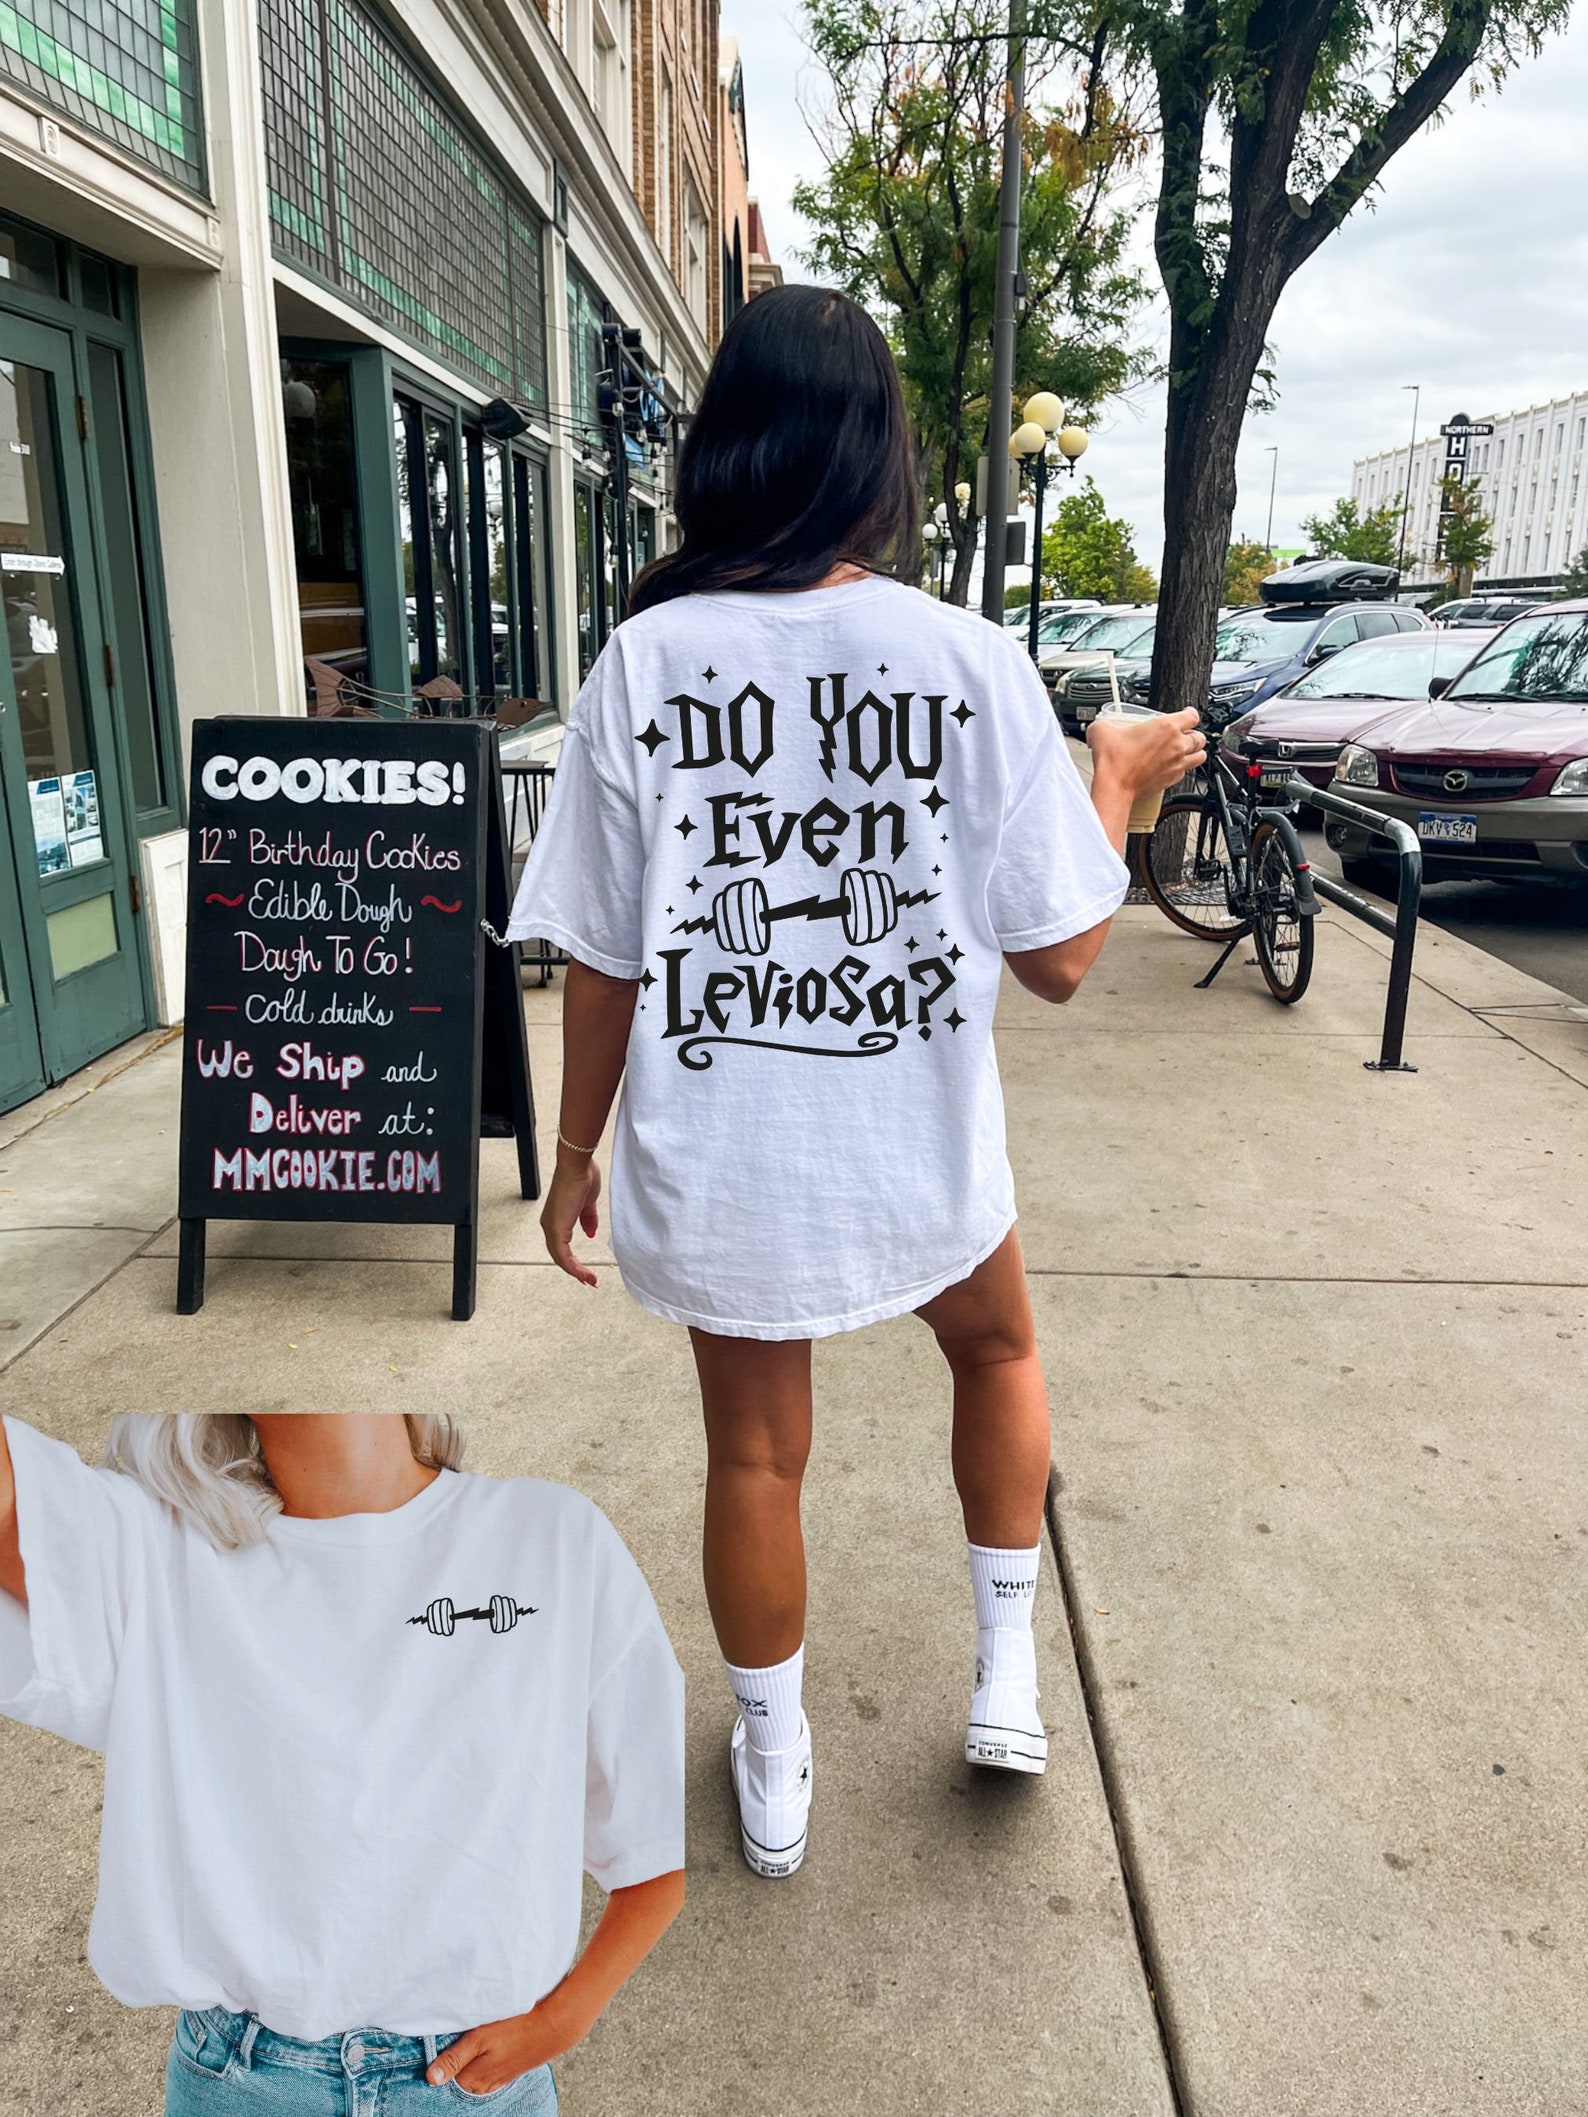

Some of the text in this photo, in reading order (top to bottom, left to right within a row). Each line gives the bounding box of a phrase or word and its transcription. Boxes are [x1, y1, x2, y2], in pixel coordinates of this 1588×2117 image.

[1445, 425, 1490, 435] NORTHERN
[664, 673, 949, 787] DO YOU
[201, 755, 467, 806] COOKIES!
[703, 792, 909, 868] Even
[249, 828, 360, 884] Birthday
[247, 878, 413, 934] Edible Dough
[233, 930, 322, 983] Dough
[325, 935, 355, 975] To
[245, 987, 316, 1026] Cold
[197, 1038, 438, 1091] We Ship and
[249, 1092, 436, 1136] Deliver at:
[211, 1148, 443, 1195] MMCOOKIE.COM
[995, 1590, 1017, 1599] SELF
[745, 1707, 769, 1717] CLUB
[978, 1740, 1008, 1748] CONVERSE
